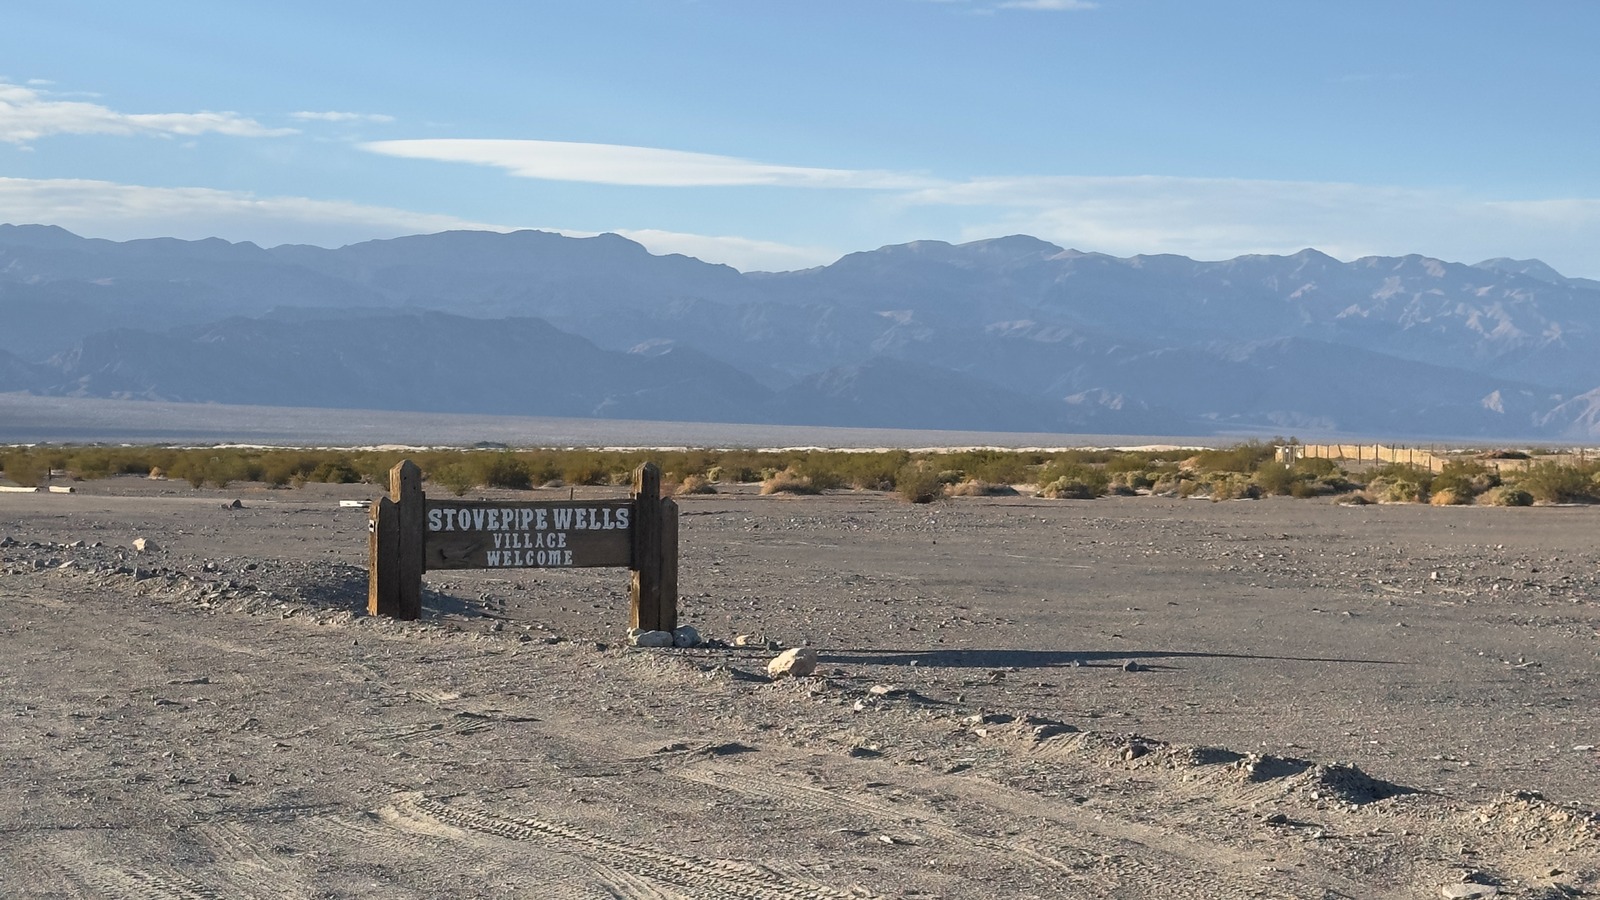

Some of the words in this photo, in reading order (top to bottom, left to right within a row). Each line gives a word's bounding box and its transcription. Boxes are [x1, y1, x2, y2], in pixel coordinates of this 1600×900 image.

[428, 508, 548, 531] STOVEPIPE
[553, 507, 630, 530] WELLS
[493, 532, 567, 549] VILLAGE
[486, 549, 574, 567] WELCOME
